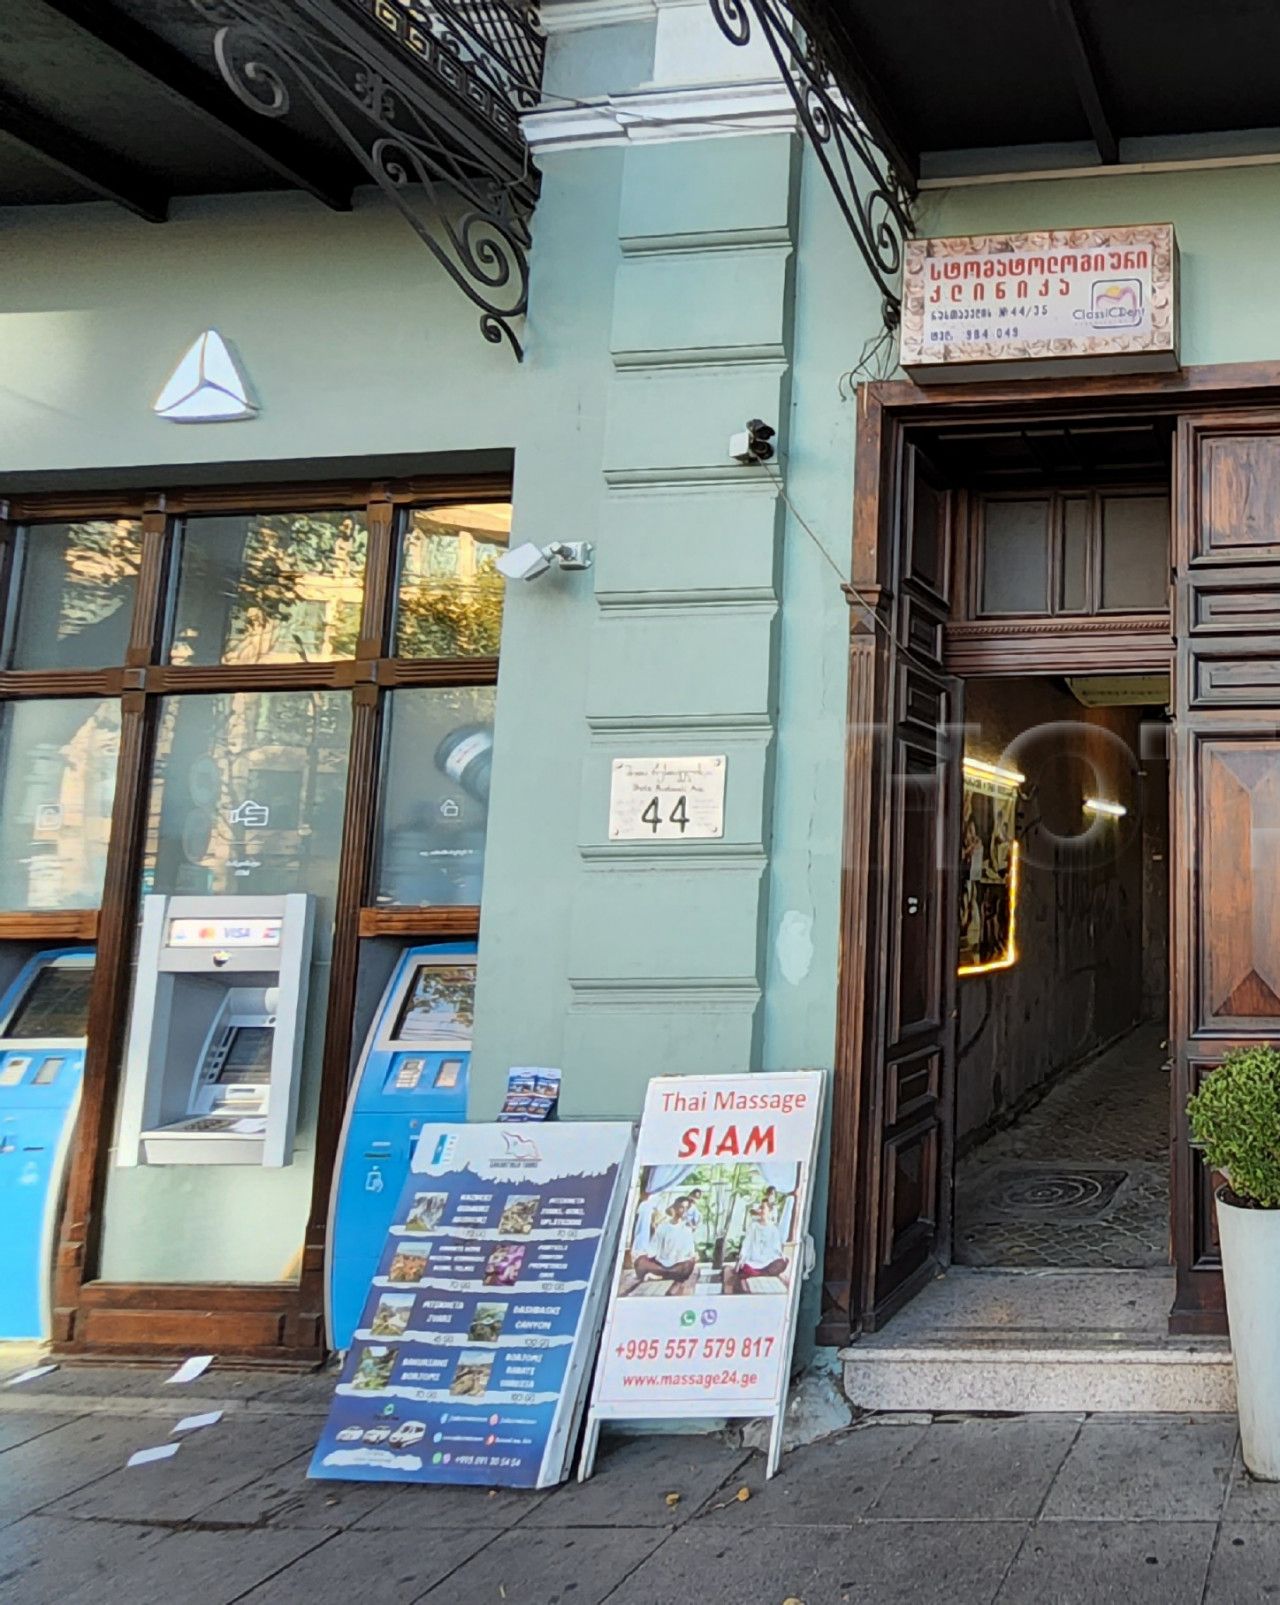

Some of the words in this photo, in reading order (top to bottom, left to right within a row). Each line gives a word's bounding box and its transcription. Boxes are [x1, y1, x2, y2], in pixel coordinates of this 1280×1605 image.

[930, 250, 1149, 281] სტომატოლოგიური
[930, 278, 1071, 303] კლინიკა
[641, 795, 691, 834] 44
[662, 1091, 708, 1113] Thai
[714, 1090, 807, 1114] Massage
[677, 1124, 776, 1158] SIAM
[615, 1339, 660, 1360] +995
[664, 1338, 699, 1359] 557
[703, 1338, 736, 1359] 579
[741, 1336, 775, 1358] 817
[622, 1369, 758, 1389] www.massage24.ge
